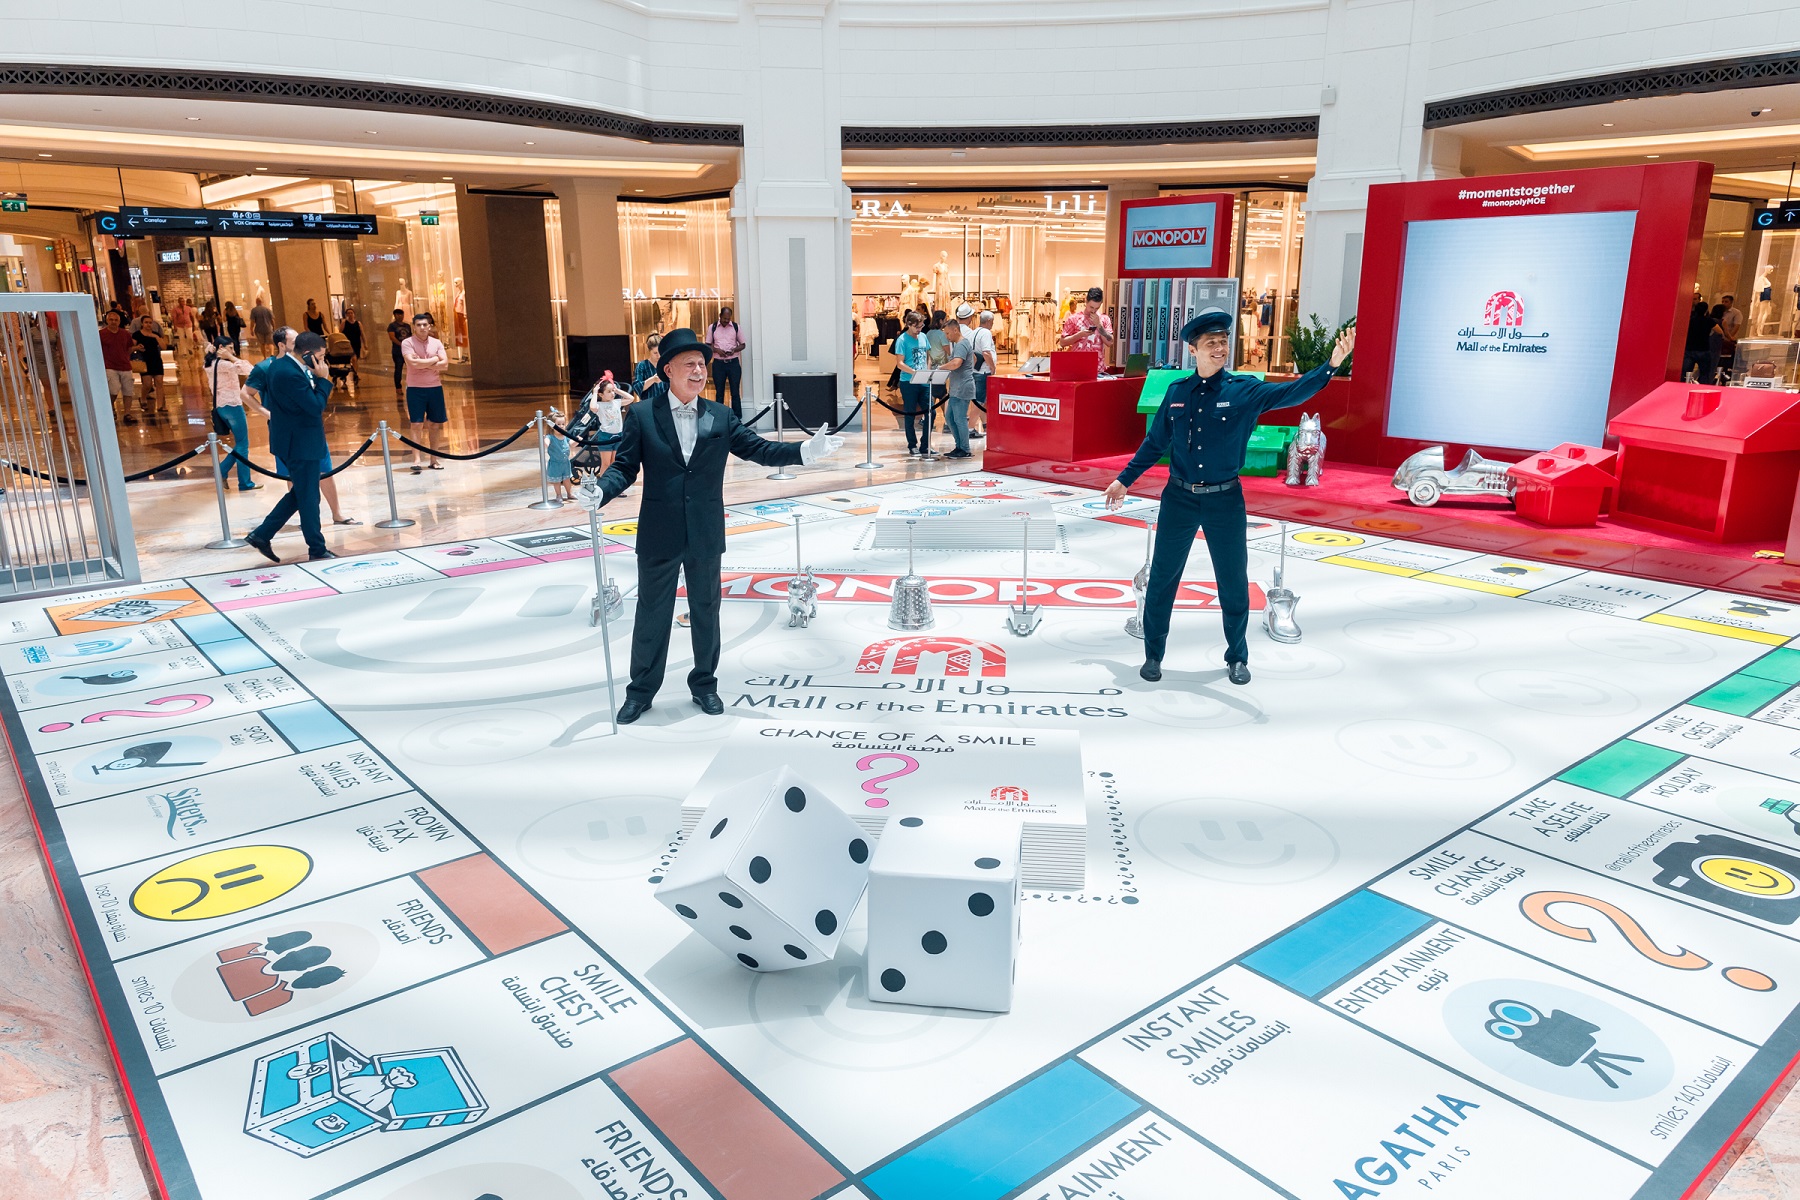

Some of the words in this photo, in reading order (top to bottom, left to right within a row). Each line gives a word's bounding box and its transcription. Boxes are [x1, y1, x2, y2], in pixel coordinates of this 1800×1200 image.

[1458, 183, 1575, 200] #momentstogether
[1482, 197, 1546, 208] #monopolyMOE
[101, 216, 117, 230] G
[860, 200, 909, 217] RA
[1758, 212, 1773, 226] G
[1133, 228, 1206, 246] MONOPOLY
[1456, 342, 1478, 352] Mall
[1502, 343, 1547, 353] Emirates
[1001, 398, 1056, 416] MONOPOLY
[720, 575, 1220, 607] ONOPO
[1689, 615, 1765, 630] COMEDY
[731, 694, 827, 710] Mall
[836, 699, 864, 711] of
[868, 699, 926, 713] the
[934, 699, 1129, 718] Emirates
[243, 726, 274, 744] SPORT
[759, 728, 866, 740] CHANCE
[878, 732, 916, 742] OF
[924, 734, 946, 743] A
[957, 734, 1036, 746] SMILE
[321, 760, 360, 789] SMILES
[346, 751, 394, 784] INSTANT
[1650, 767, 1704, 798] HOLIDAY
[404, 806, 454, 842] FROWN
[1508, 798, 1556, 821] TAKE
[1542, 801, 1594, 830] SELFIE
[384, 820, 418, 843] TAX
[1532, 825, 1558, 838] A
[1604, 820, 1682, 872] @malloftheemirates
[1408, 850, 1466, 881] SMILE
[1434, 856, 1506, 897] CHANCE
[95, 882, 111, 899] lose
[102, 896, 119, 908] 70
[396, 898, 453, 945] FRIENDS
[1334, 928, 1466, 1014] ENTERTAINMENT
[132, 975, 154, 1004] smiles
[144, 1001, 165, 1015] 10
[540, 976, 605, 1026] CHEST
[573, 964, 638, 1014] SMILE
[1122, 985, 1230, 1052] INSTANT
[1166, 1010, 1256, 1066] SMILES
[1650, 1105, 1689, 1140] smiles
[1674, 1084, 1705, 1106] 140
[594, 1119, 688, 1200] FRIENDS
[1332, 1093, 1481, 1200] AGATHA
[1417, 1145, 1471, 1190] PARIS
